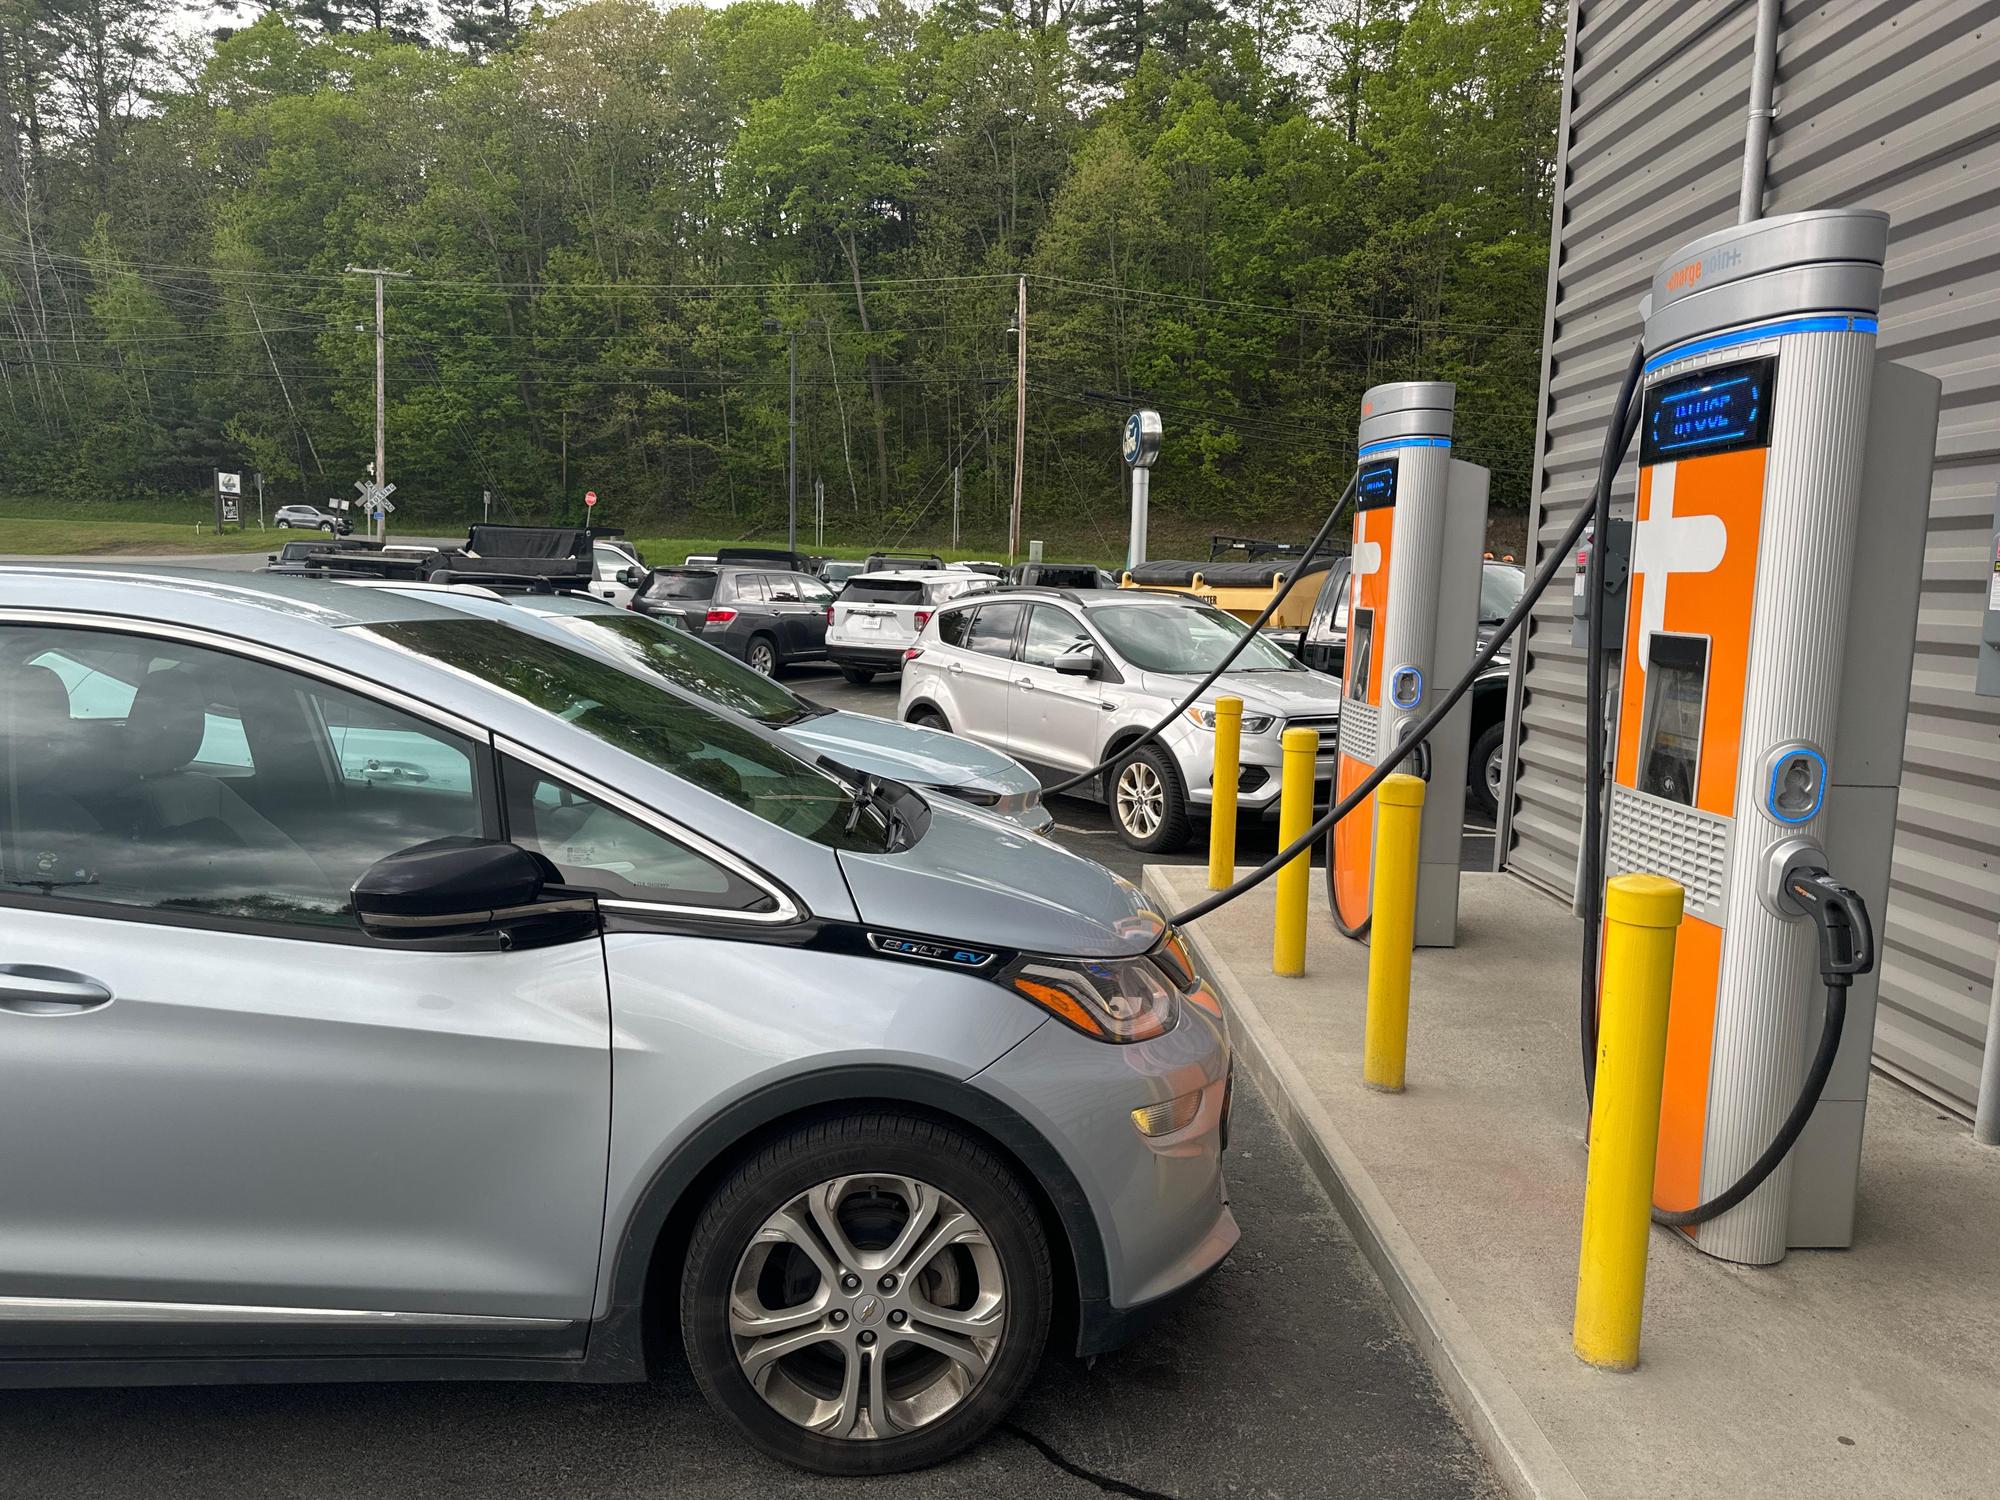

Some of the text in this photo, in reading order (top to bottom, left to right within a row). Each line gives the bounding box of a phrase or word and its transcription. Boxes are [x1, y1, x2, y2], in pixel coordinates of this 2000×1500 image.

[365, 484, 396, 509] CROSSING
[366, 481, 378, 496] RAIL
[883, 939, 986, 963] BOLT EV
